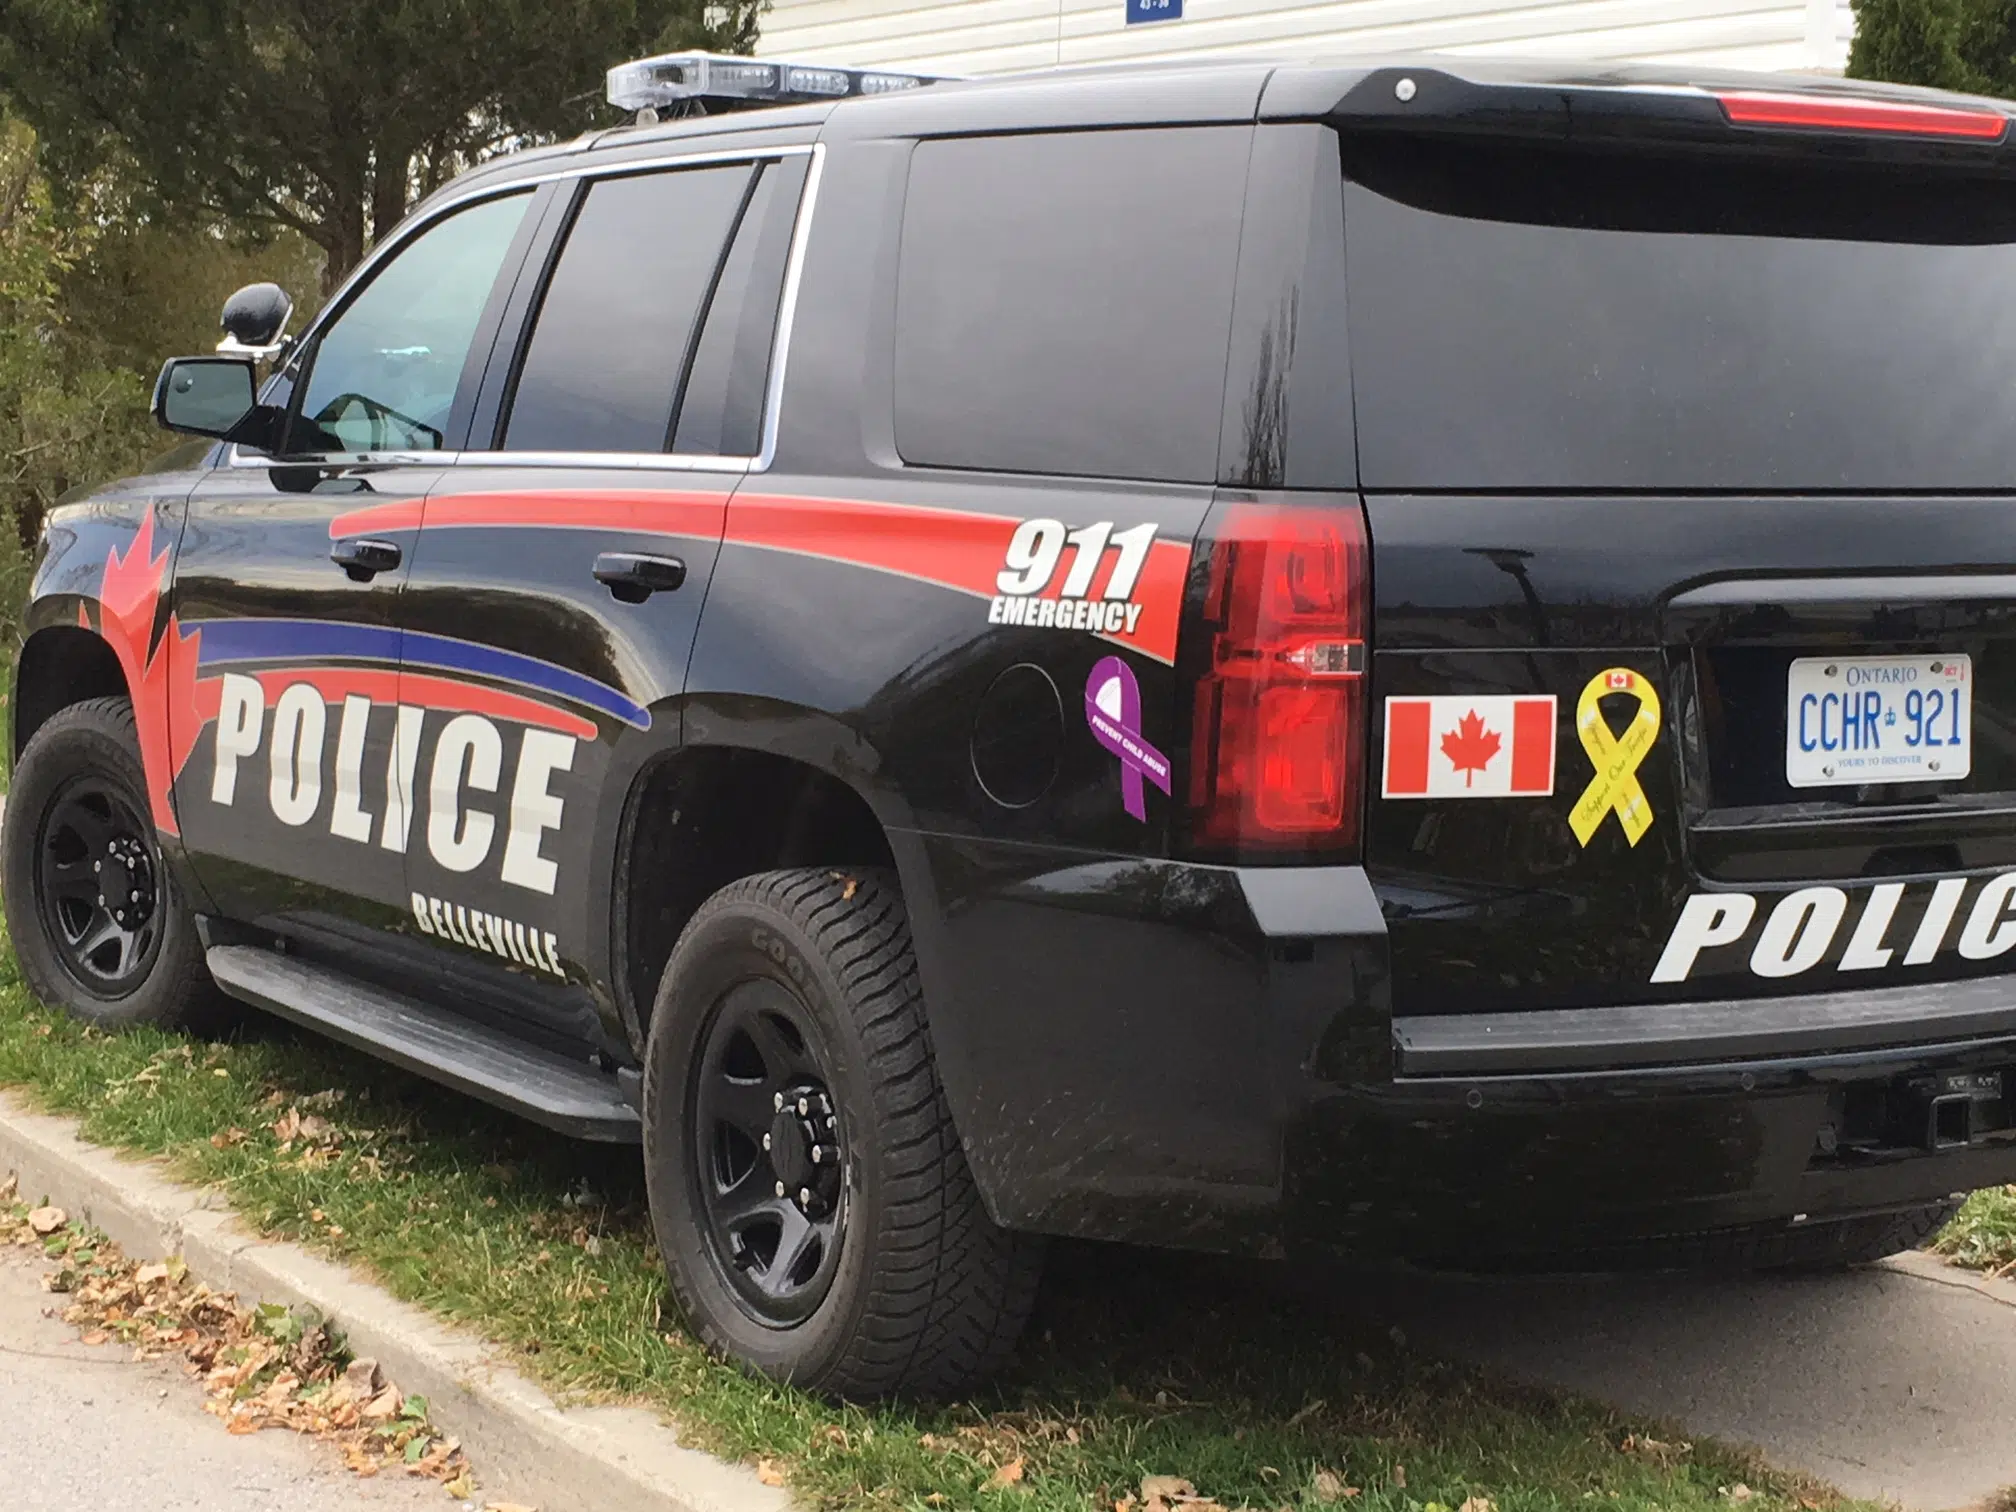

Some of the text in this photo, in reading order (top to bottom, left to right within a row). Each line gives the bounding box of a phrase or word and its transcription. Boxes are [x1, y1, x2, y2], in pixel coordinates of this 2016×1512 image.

[996, 518, 1159, 600] 911
[988, 596, 1142, 633] EMERGENCY
[1122, 738, 1144, 760] CHILD
[1799, 688, 1962, 752] CCHR 921
[211, 672, 578, 895] POLICE
[412, 892, 566, 977] BELLEVILLE
[1649, 872, 2016, 984] POLIC
